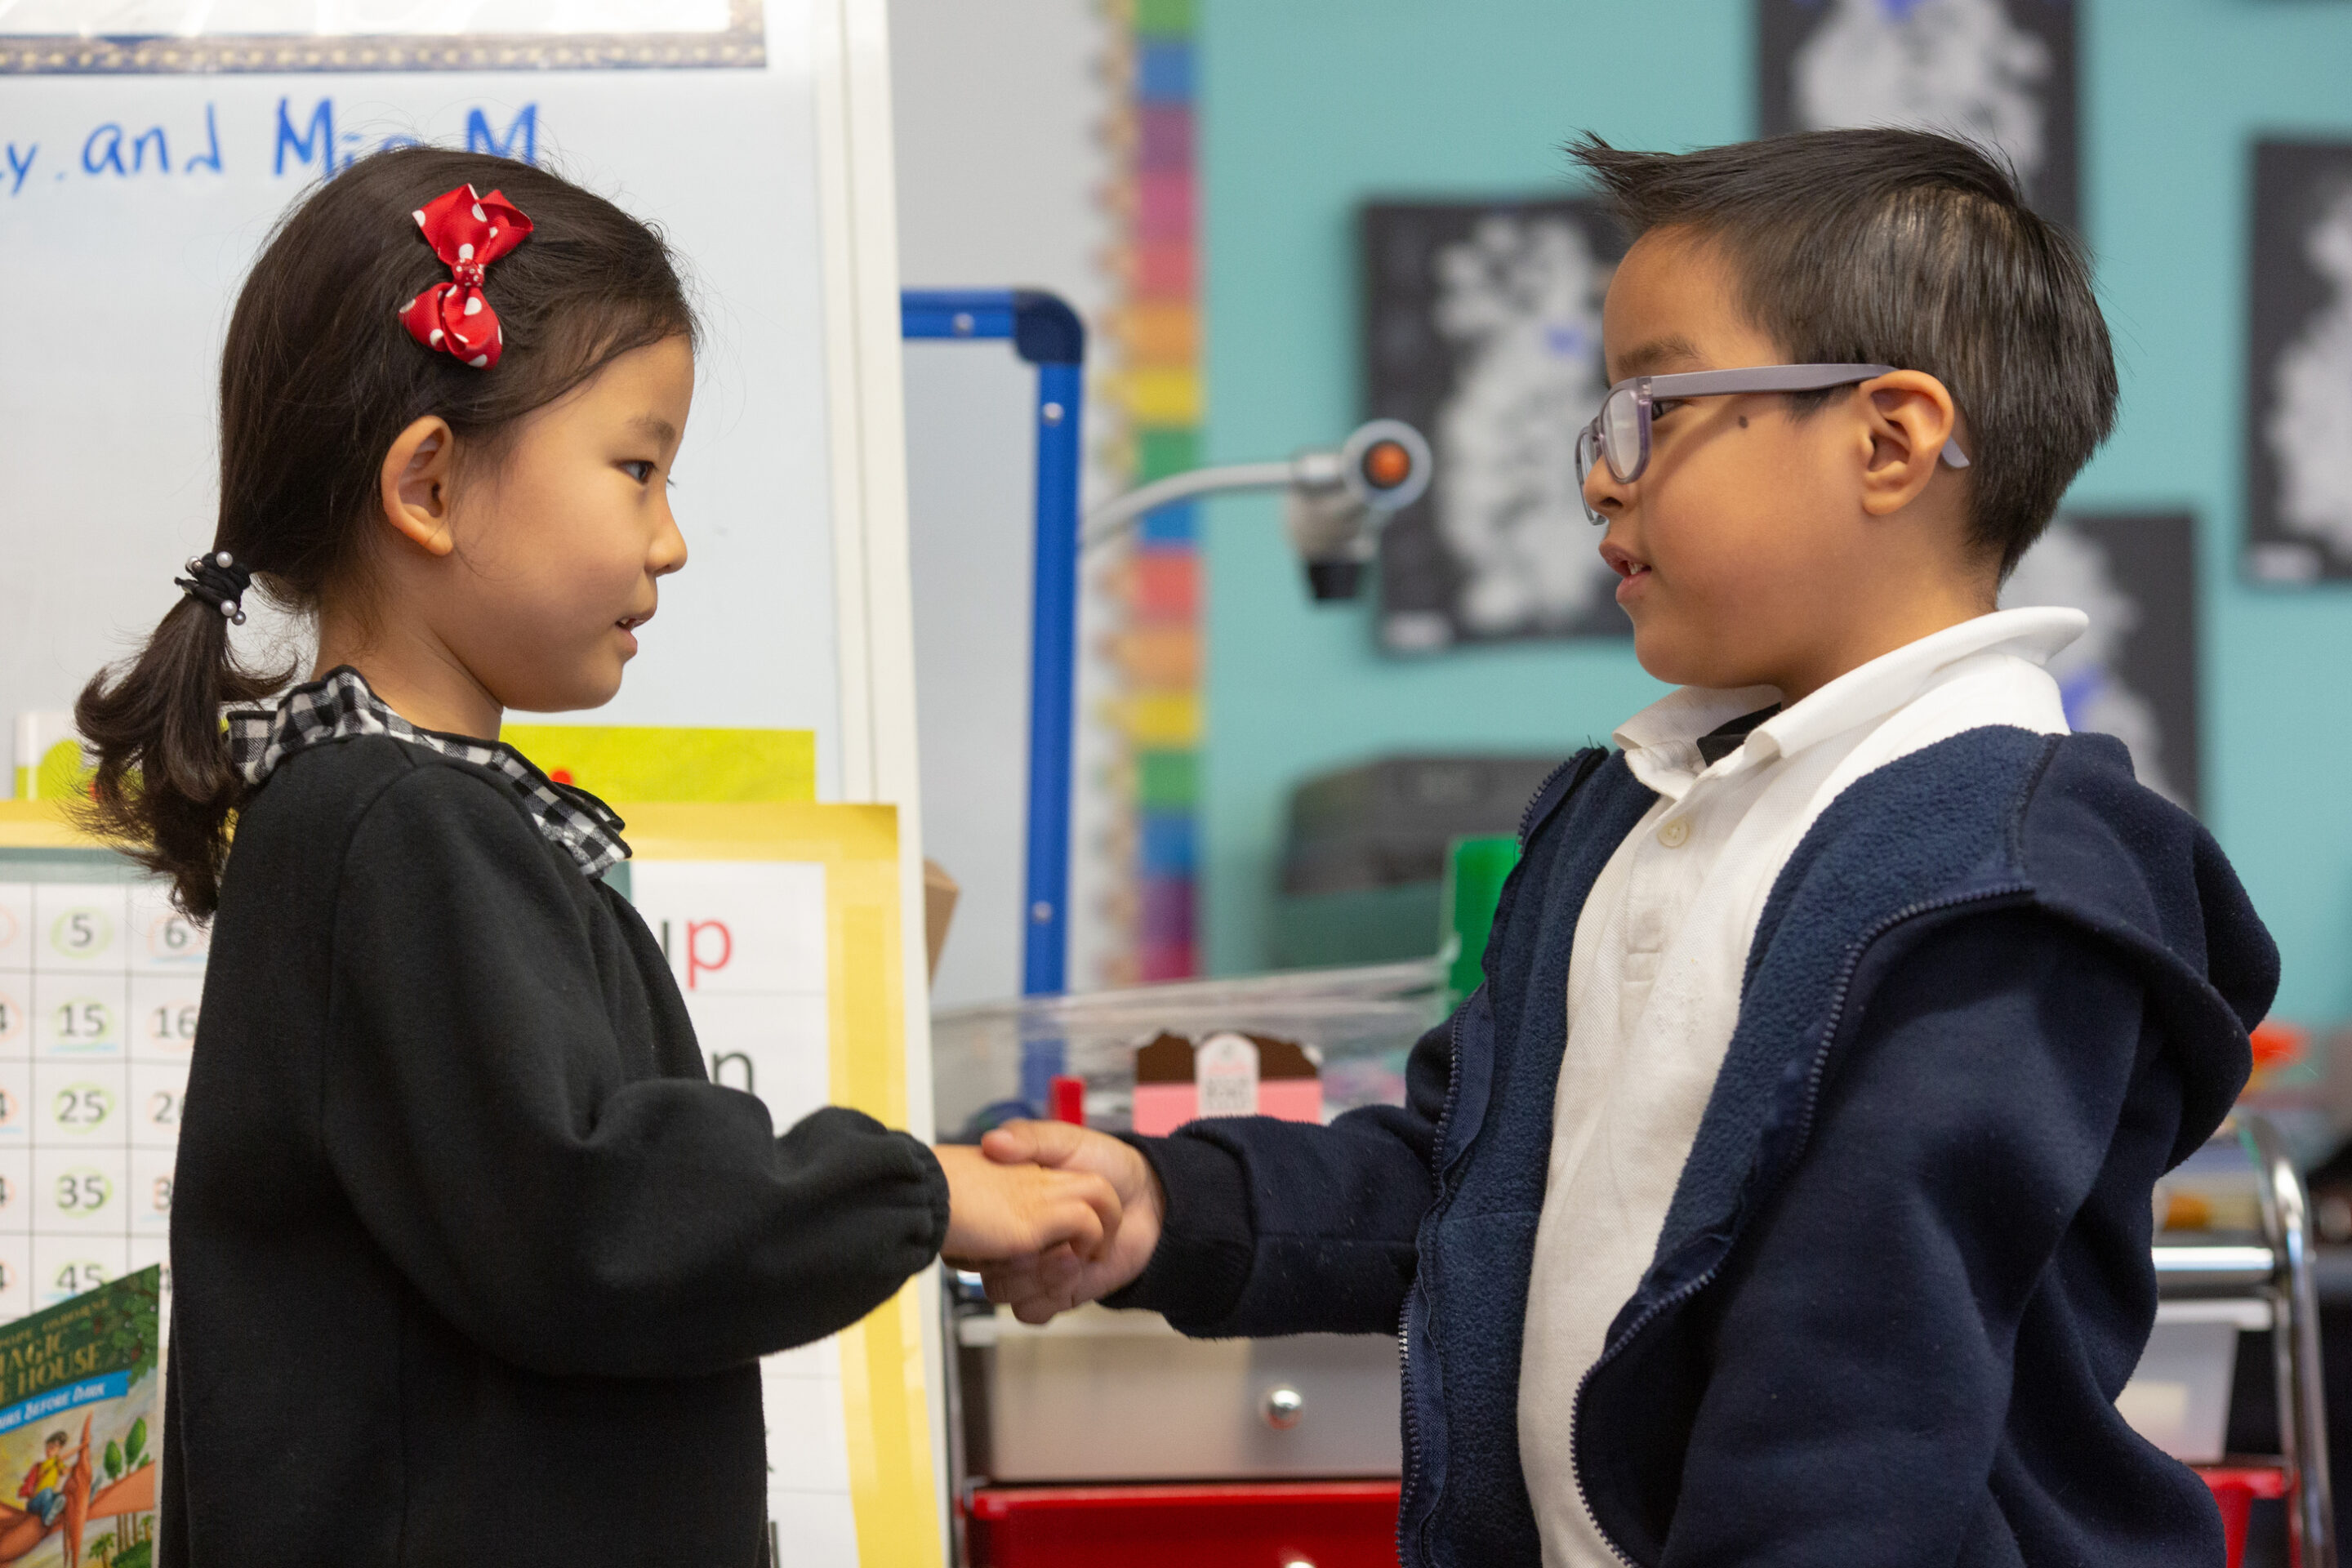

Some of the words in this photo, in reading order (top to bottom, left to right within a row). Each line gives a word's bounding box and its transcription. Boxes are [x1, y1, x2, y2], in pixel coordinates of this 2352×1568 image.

[81, 100, 223, 177] and
[69, 912, 94, 948] 5
[164, 916, 189, 950] 6
[60, 1003, 106, 1038] 15
[154, 1004, 198, 1040] 16
[58, 1088, 105, 1124] 25
[153, 1090, 187, 1125] 2
[56, 1174, 105, 1210] 35
[56, 1263, 102, 1291] 45
[17, 1339, 105, 1396] HOUSE
